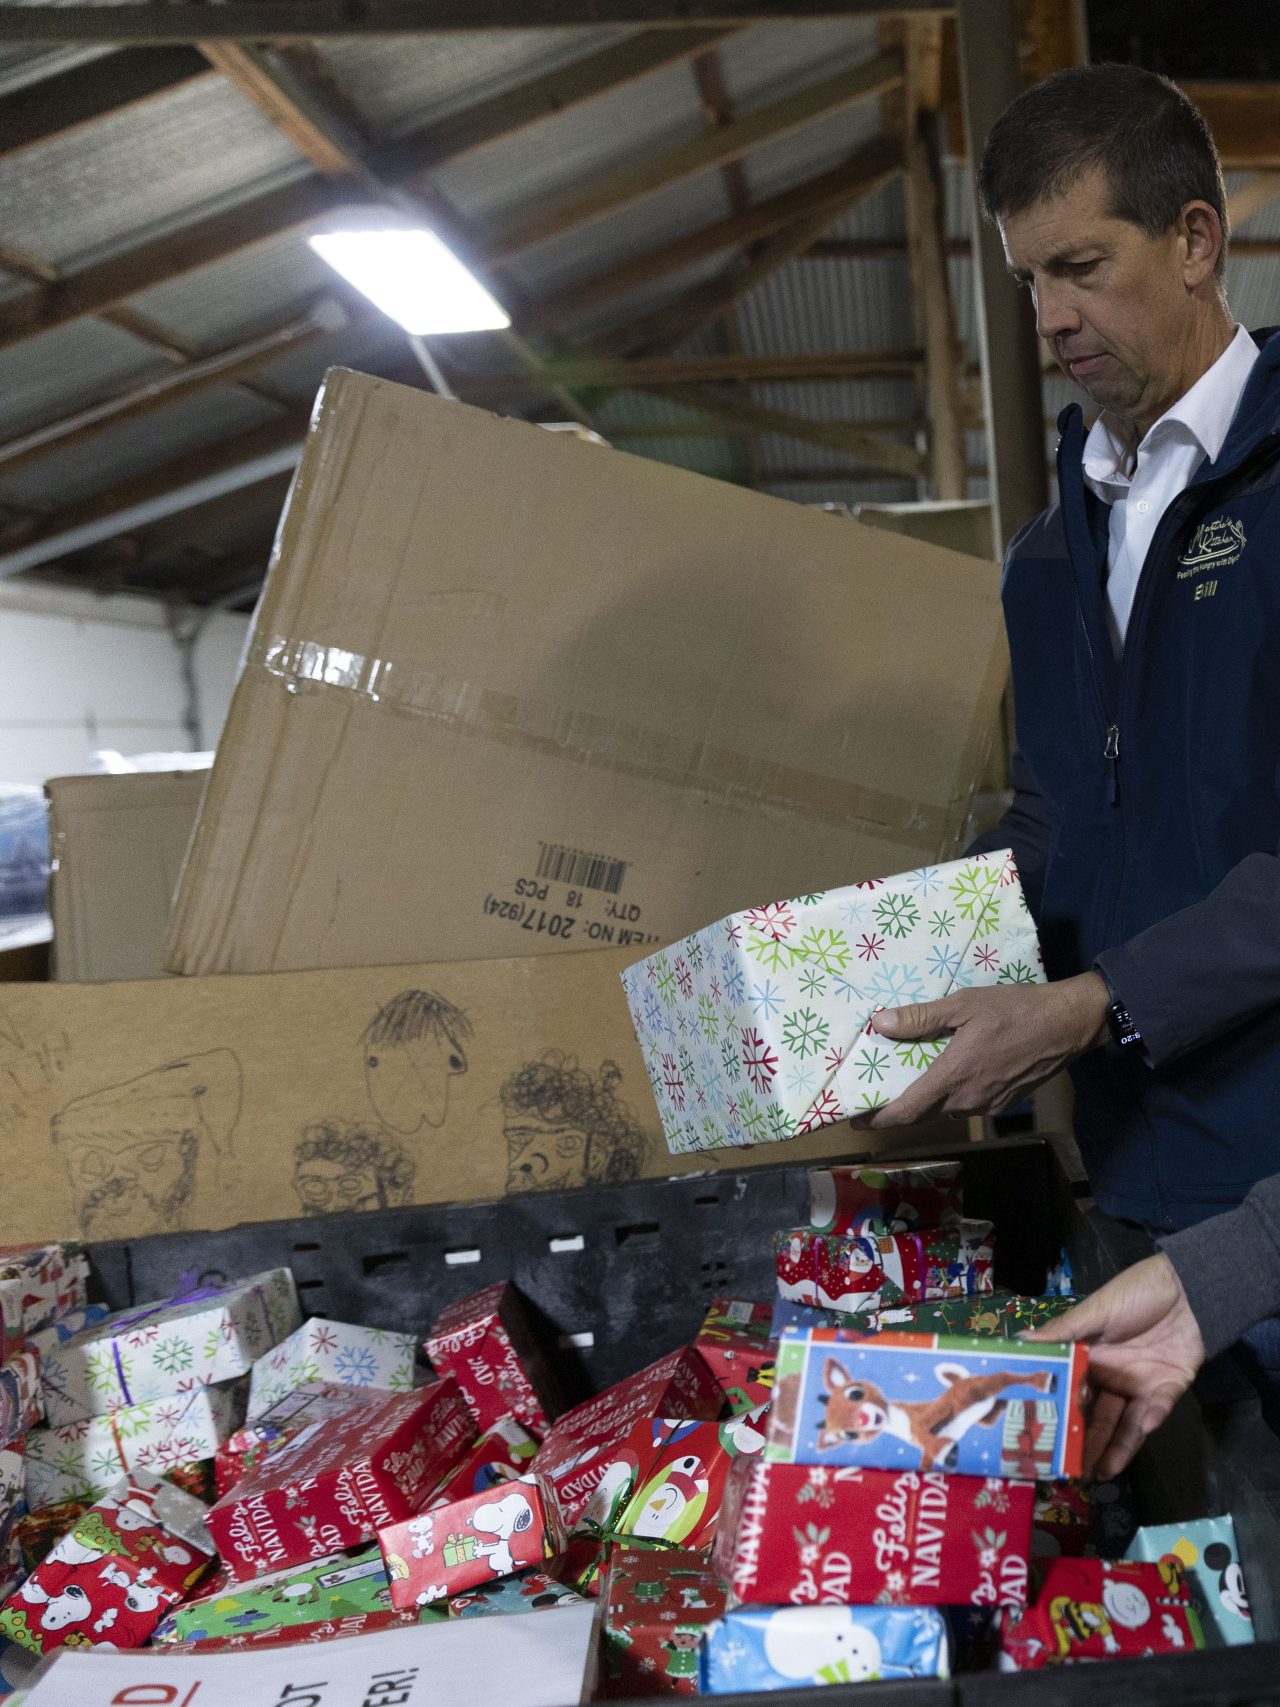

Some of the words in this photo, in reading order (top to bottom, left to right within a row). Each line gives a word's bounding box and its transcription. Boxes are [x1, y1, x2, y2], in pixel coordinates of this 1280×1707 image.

[515, 877, 549, 901] PCS
[565, 889, 583, 909] 18
[484, 892, 576, 939] 2017(924)
[605, 899, 641, 922] QTY:
[584, 919, 615, 944] NO:
[228, 1498, 258, 1564] Feliz
[873, 1470, 919, 1572] Feliz
